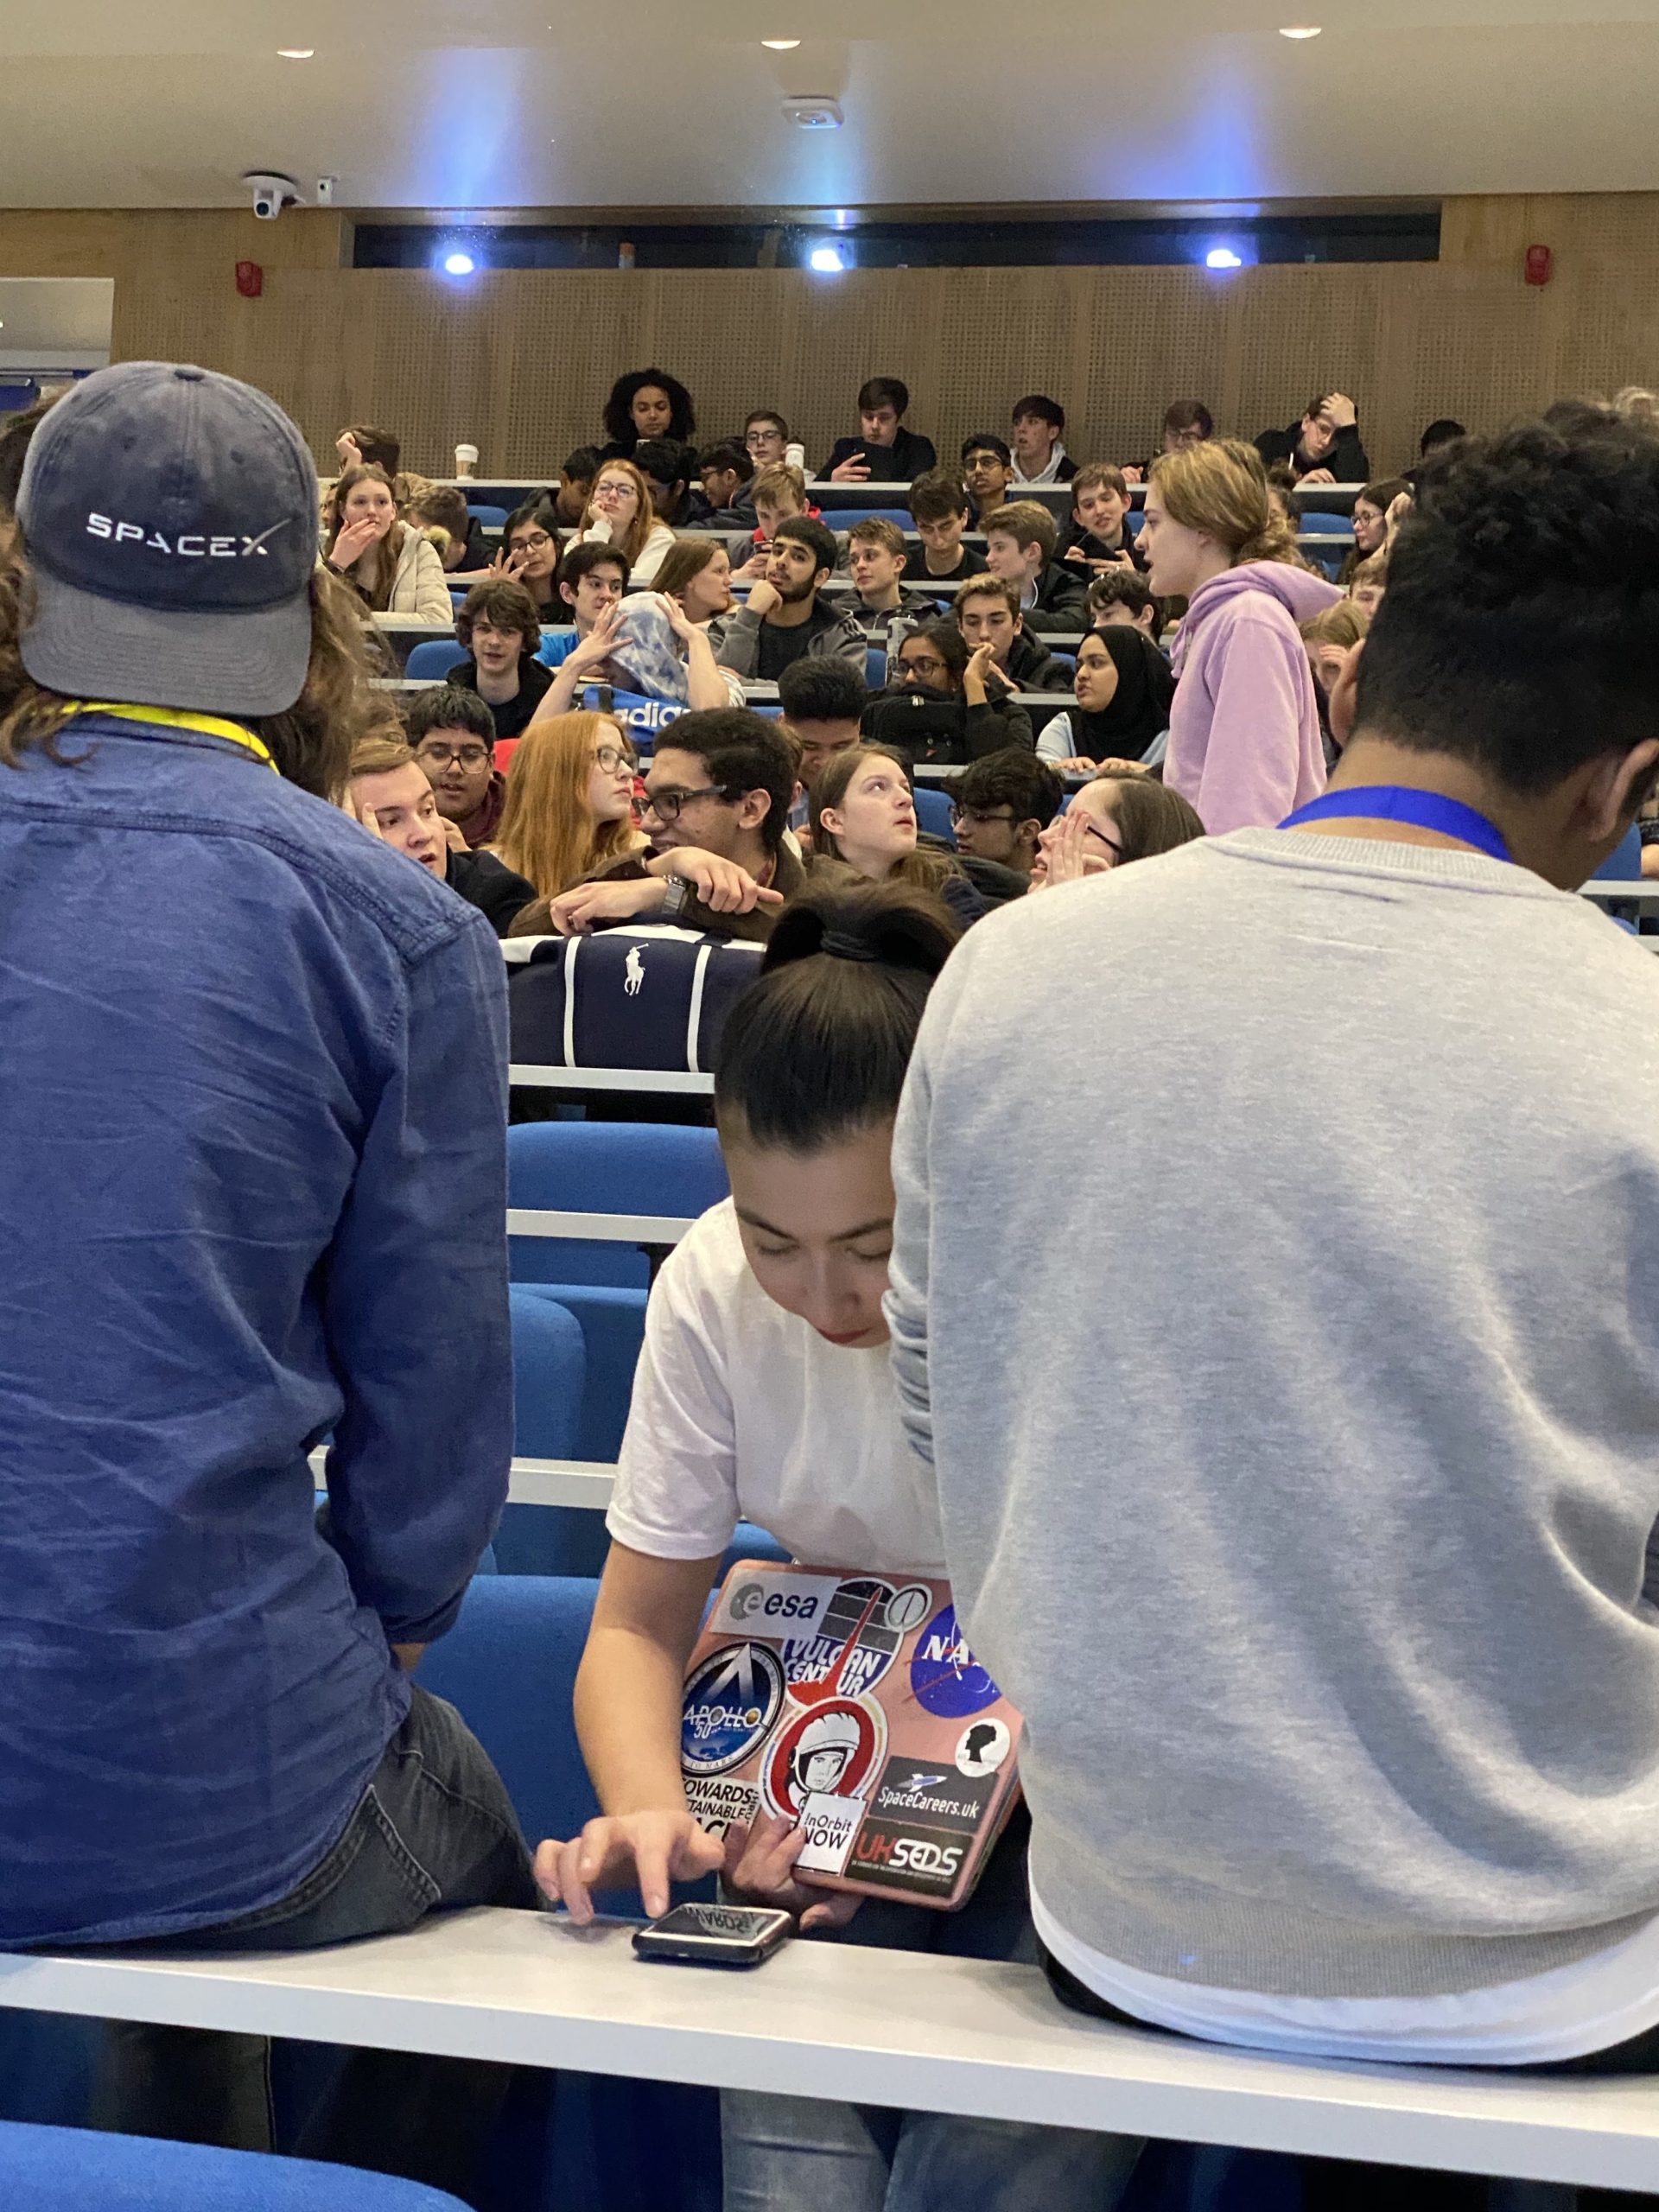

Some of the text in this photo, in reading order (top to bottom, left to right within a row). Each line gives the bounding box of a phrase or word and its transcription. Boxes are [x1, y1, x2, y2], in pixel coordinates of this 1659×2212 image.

[86, 512, 292, 556] SPACEX
[764, 1592, 818, 1619] esa
[785, 1657, 865, 1697] CENTUR
[683, 1704, 762, 1728] APOLLO
[693, 1721, 712, 1739] 50
[683, 1779, 754, 1805] OWARDS
[878, 1786, 980, 1819] SpaceCareers.uk
[687, 1798, 747, 1820] TAINABLE
